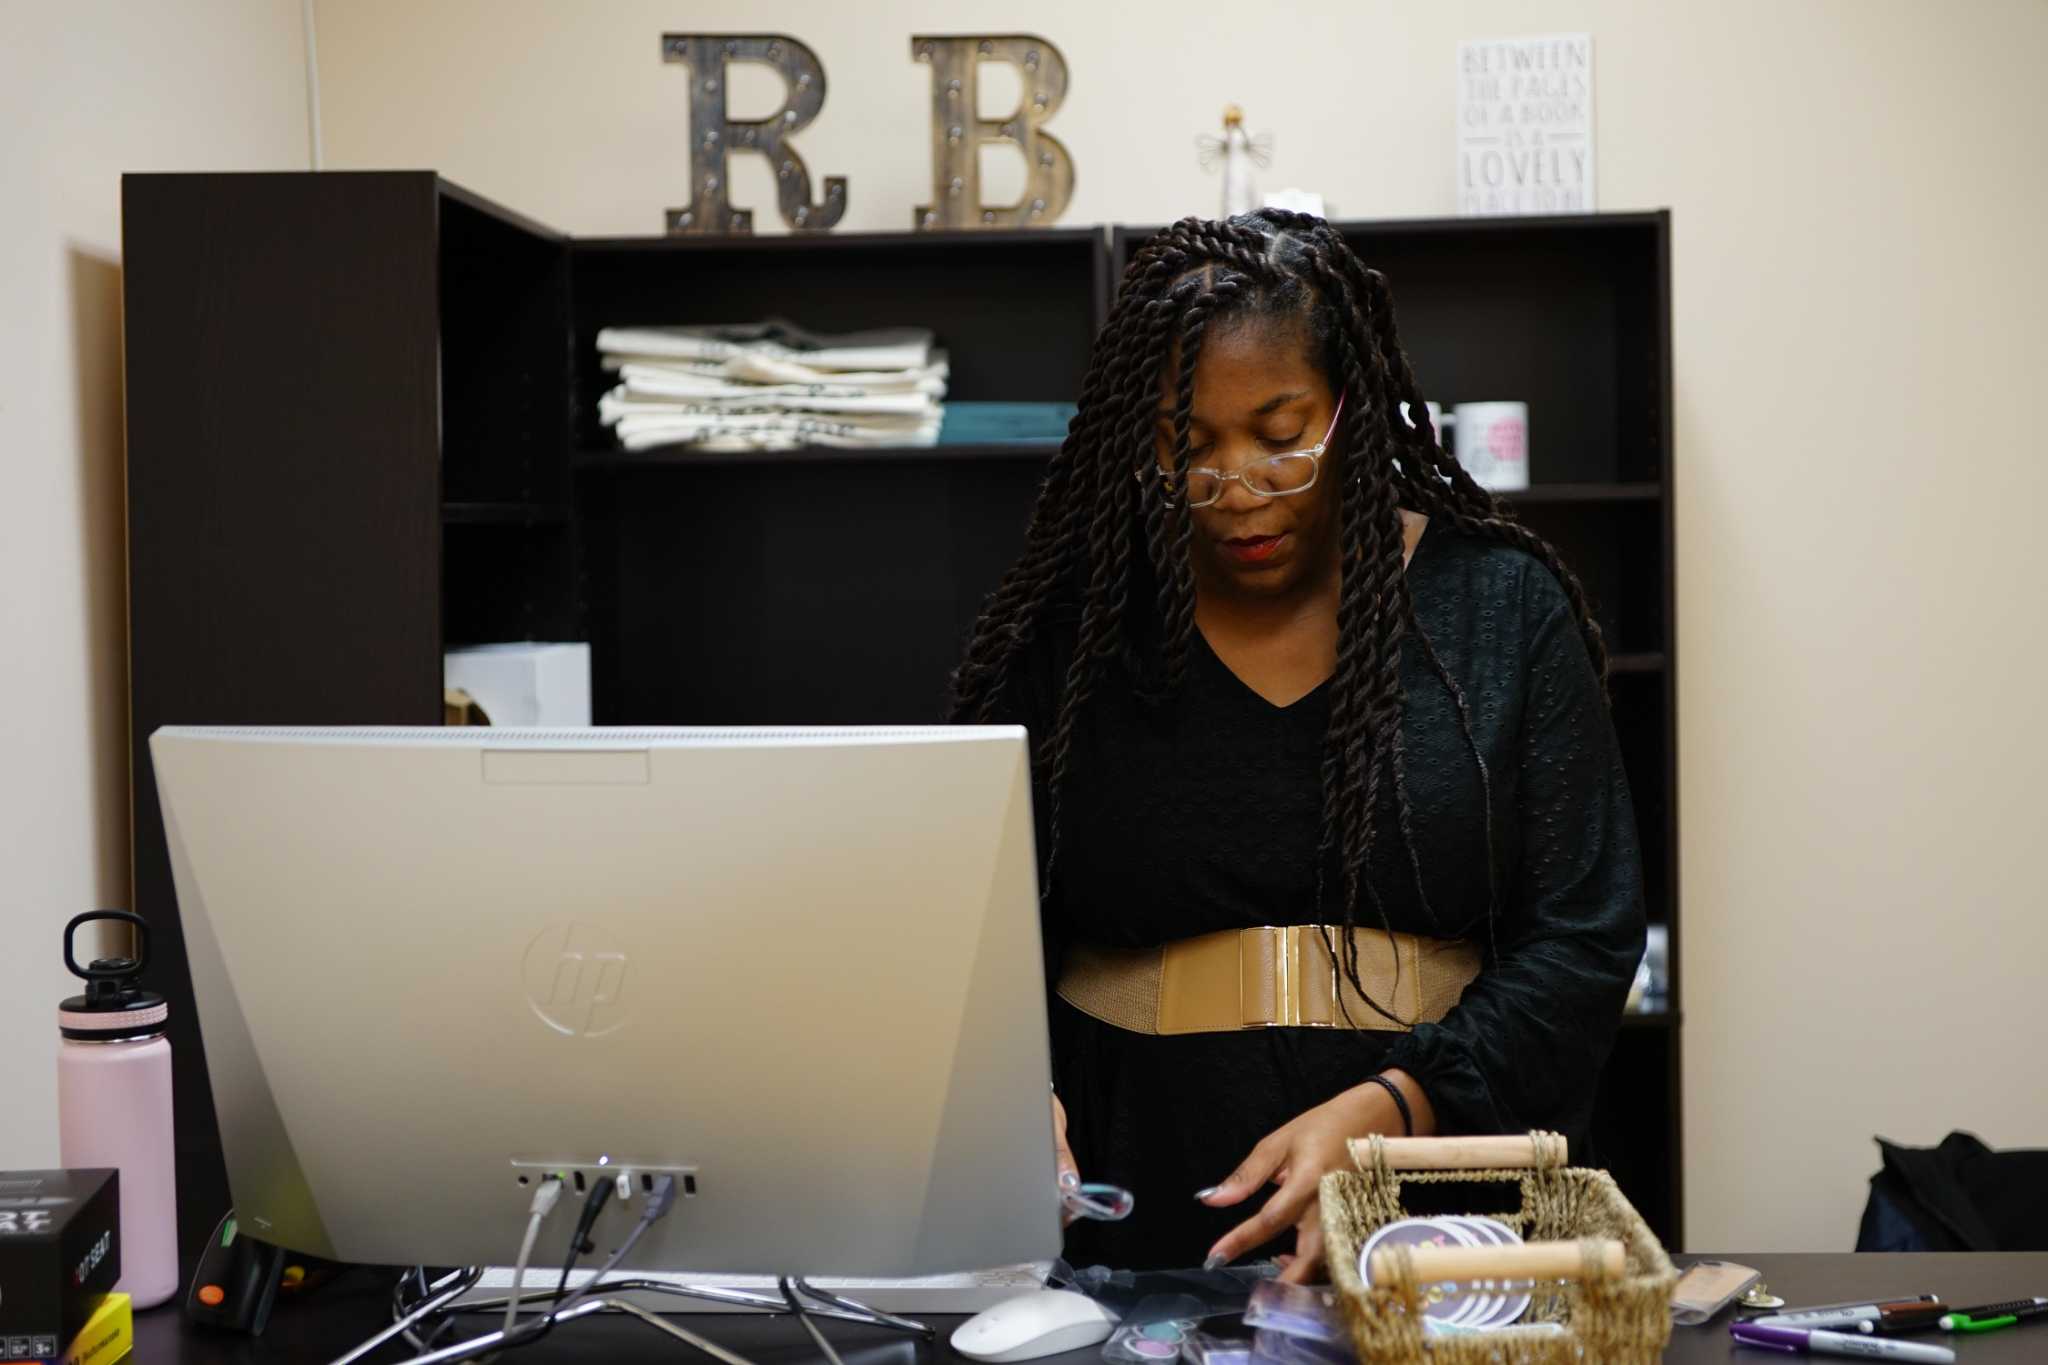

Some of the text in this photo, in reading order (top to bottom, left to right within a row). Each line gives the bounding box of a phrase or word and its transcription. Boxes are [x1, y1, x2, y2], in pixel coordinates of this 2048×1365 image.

[1463, 40, 1586, 73] BETWEEN
[1465, 71, 1586, 103] THE PAGES
[1463, 100, 1585, 127] OF A BOOK
[1463, 147, 1585, 188] LOVELY
